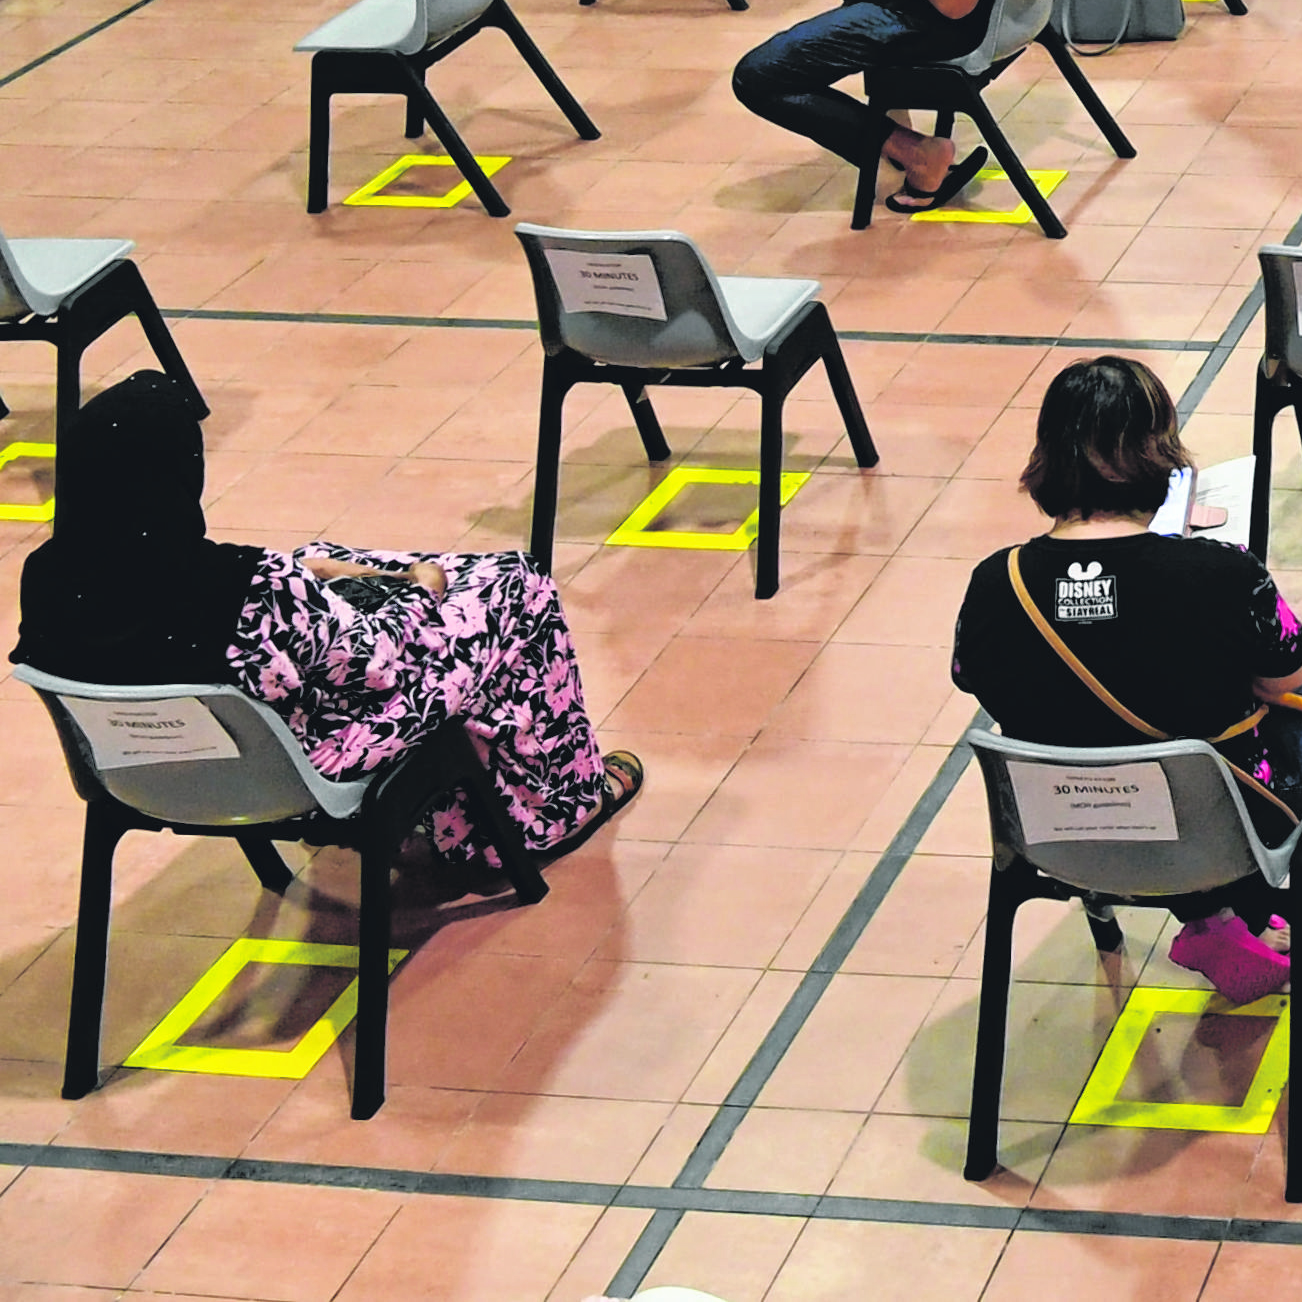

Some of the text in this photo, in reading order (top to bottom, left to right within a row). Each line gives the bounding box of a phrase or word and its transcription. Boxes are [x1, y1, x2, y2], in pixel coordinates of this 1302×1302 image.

[593, 271, 640, 281] MINUTES
[1059, 579, 1112, 598] DISNEY
[1058, 596, 1113, 605] COLLECTION
[124, 719, 186, 729] MINUTES
[1053, 785, 1139, 794] 30 MINUTES
